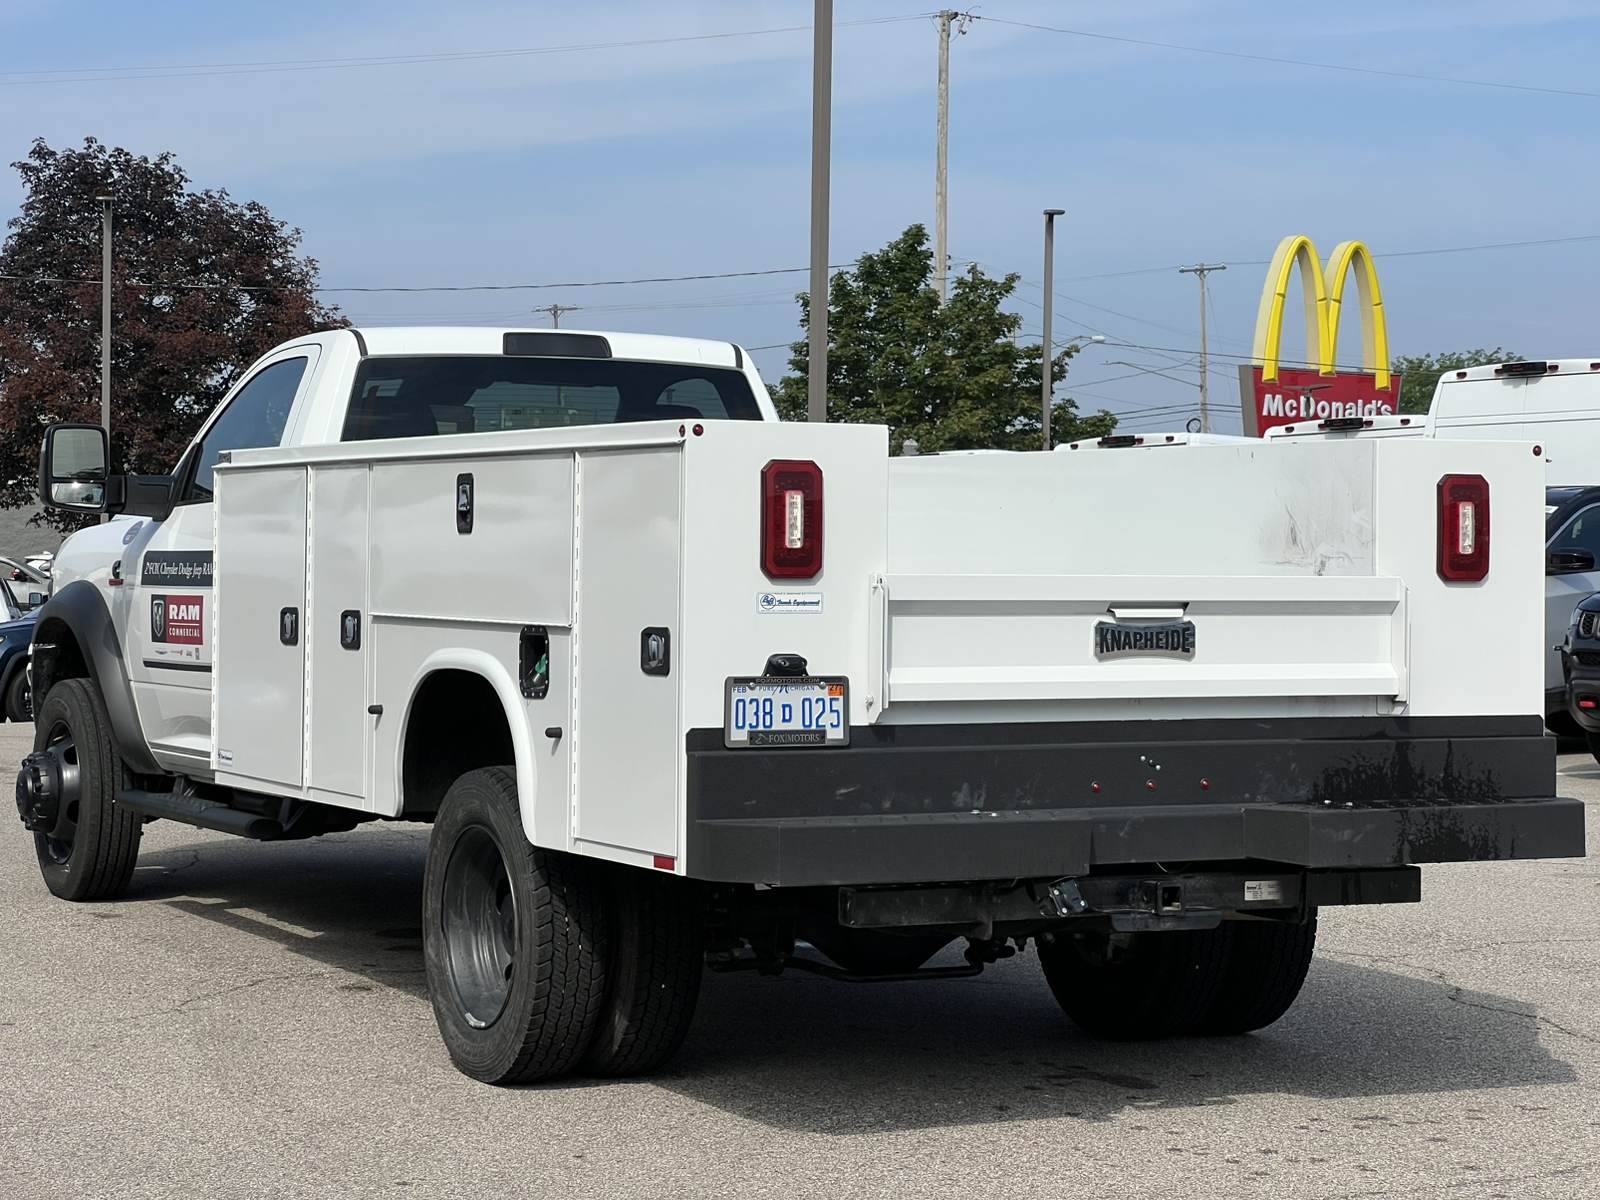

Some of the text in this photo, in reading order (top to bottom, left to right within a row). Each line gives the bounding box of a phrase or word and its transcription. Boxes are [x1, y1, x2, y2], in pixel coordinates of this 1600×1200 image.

[1262, 394, 1393, 419] McDonald's
[178, 562, 192, 579] Dodge
[191, 562, 202, 579] Jeep
[169, 604, 200, 621] RAM
[168, 627, 200, 637] COMMERCIAL
[1099, 626, 1191, 654] KNAPHEIDE
[732, 686, 747, 694] FEB
[778, 684, 815, 694] MICHIGAN
[735, 697, 773, 730] 038
[801, 697, 841, 729] 025
[768, 733, 820, 743] FOX MOTORS
